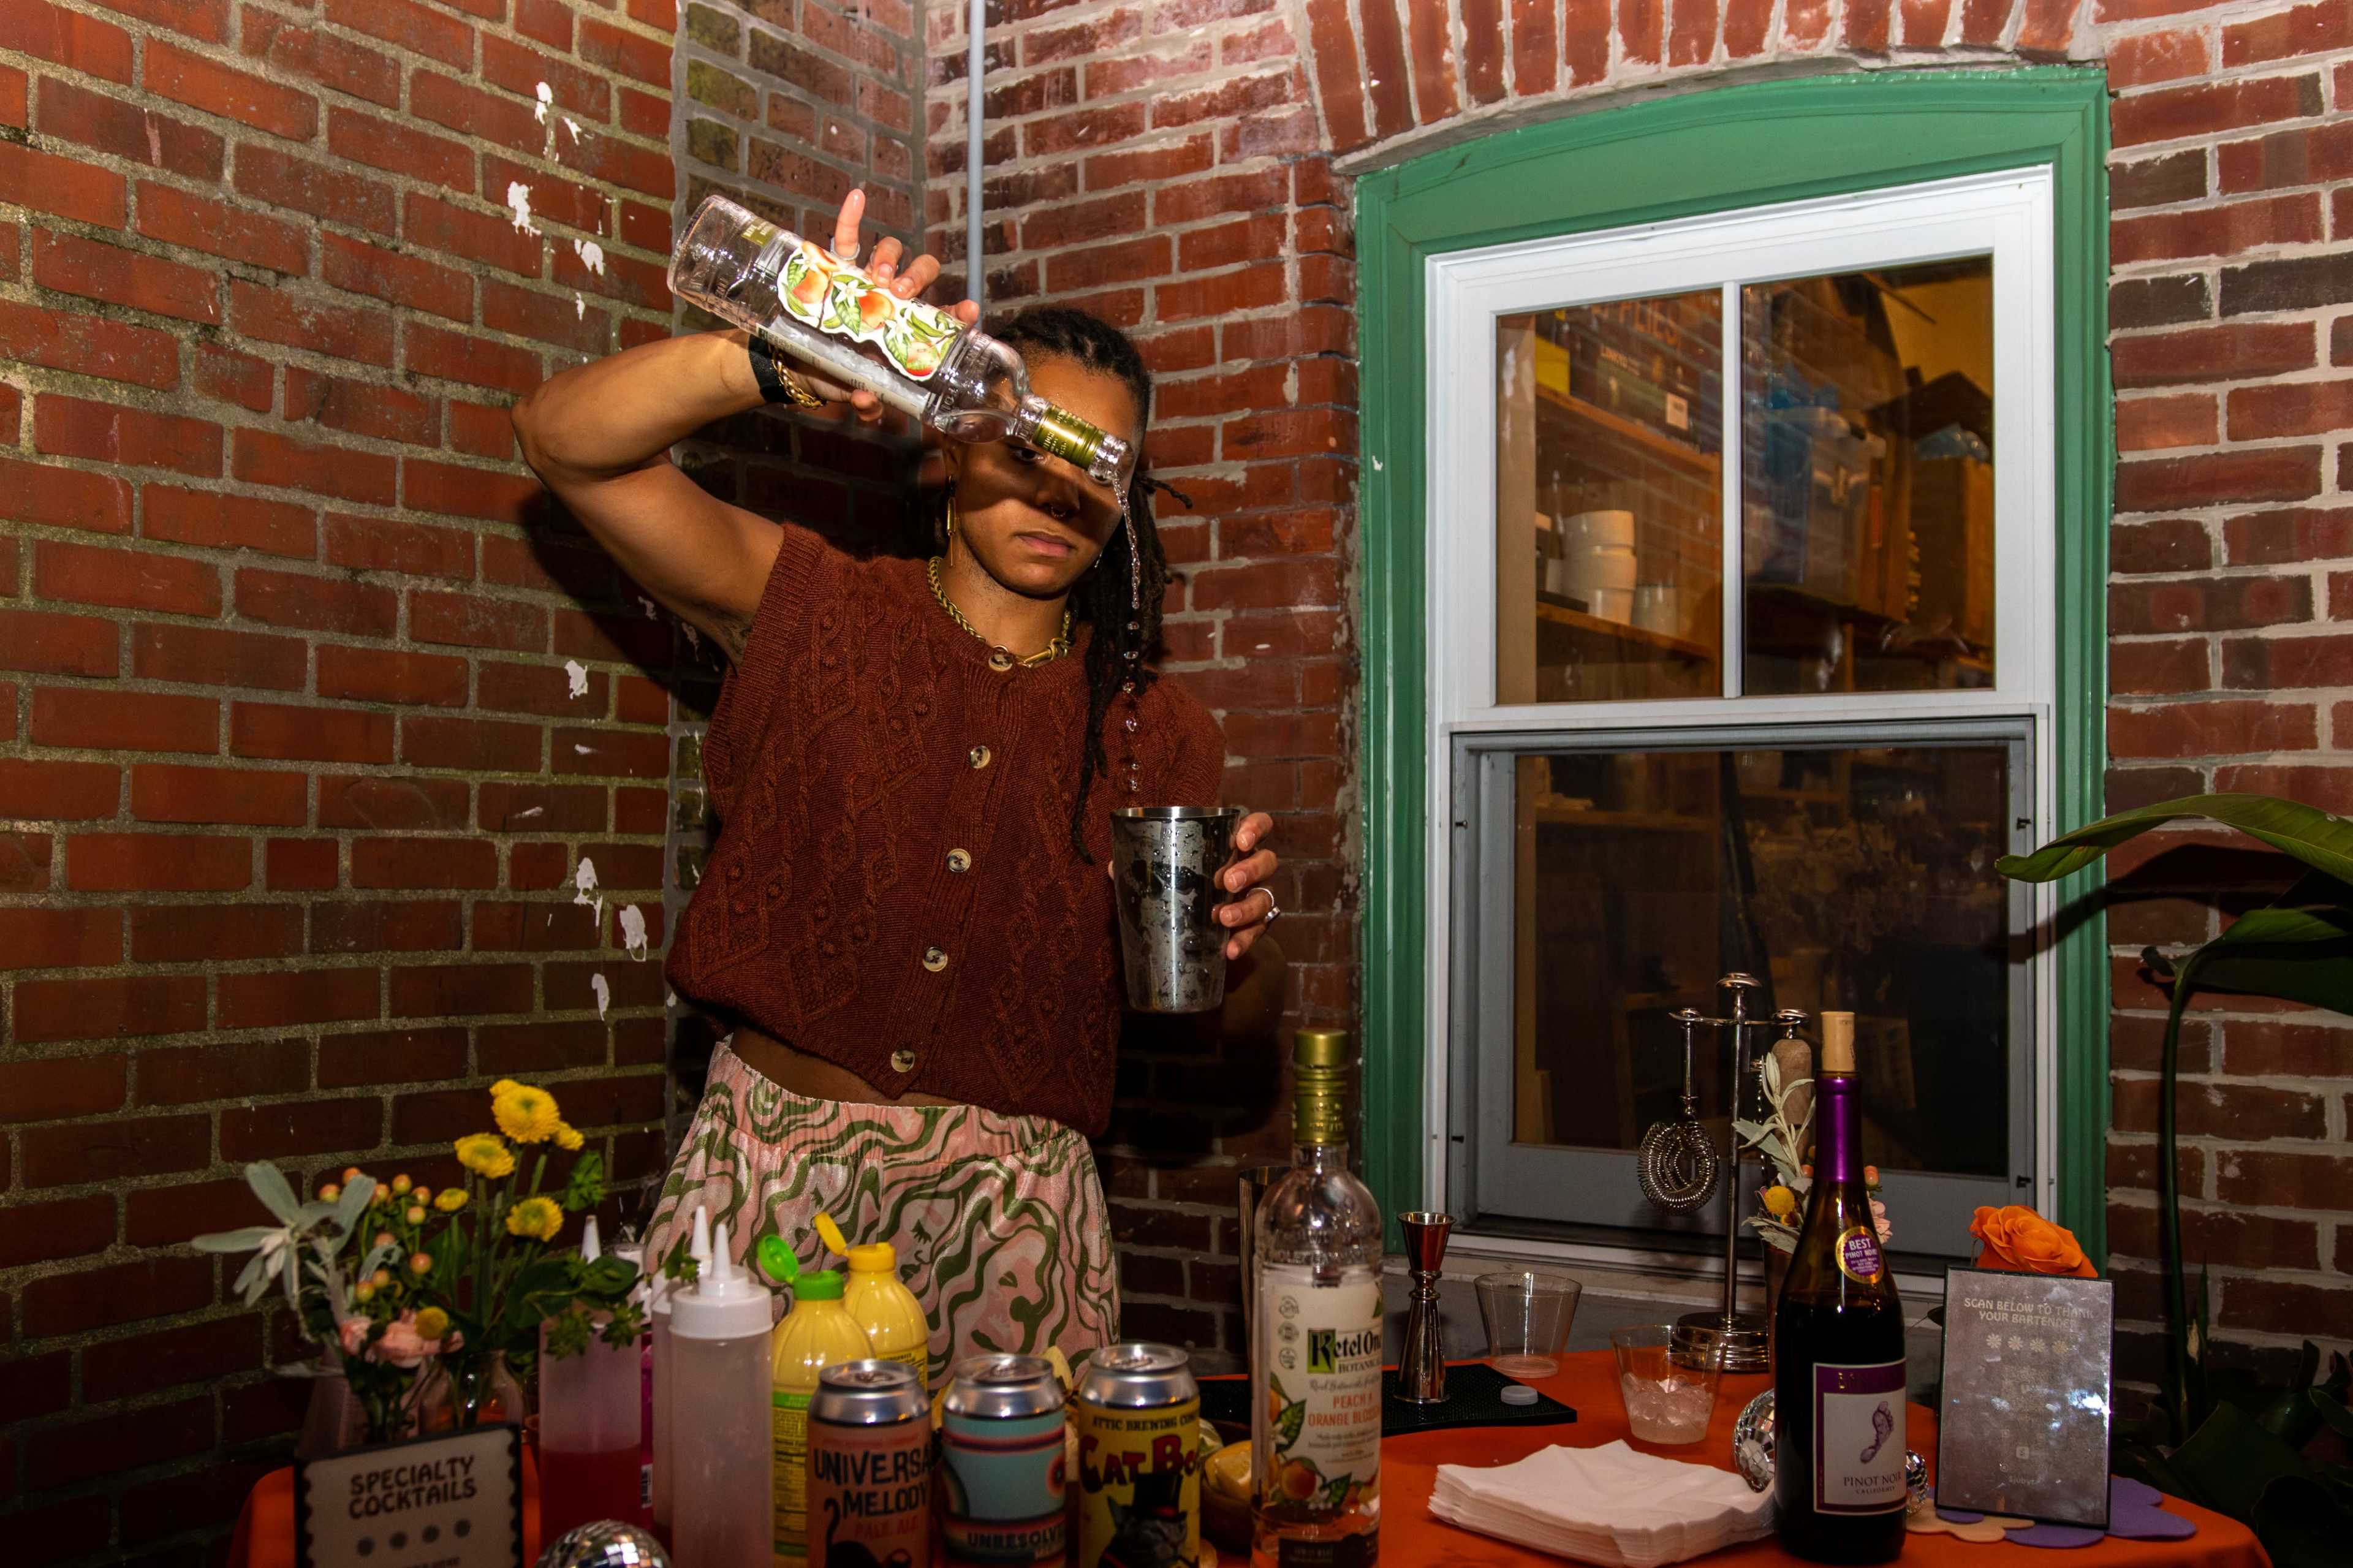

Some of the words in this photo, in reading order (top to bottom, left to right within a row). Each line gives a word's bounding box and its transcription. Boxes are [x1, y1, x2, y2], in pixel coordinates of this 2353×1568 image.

[1849, 1238, 1871, 1251] BEST
[1845, 1251, 1863, 1259] PINOT
[1964, 1298, 1993, 1309] SCAN
[1996, 1300, 2034, 1313] BELOW
[2037, 1304, 2052, 1315] TO
[2056, 1306, 2095, 1320] THANK
[1979, 1310, 2009, 1322] YOUR
[2012, 1313, 2076, 1330] BARTENDER
[1311, 1333, 1362, 1371] Ketel
[1333, 1393, 1366, 1409] PEACH
[1093, 1416, 1123, 1431] ATTIC
[1126, 1417, 1177, 1431] BREWING
[1308, 1412, 1349, 1427] ORANGE
[350, 1455, 474, 1496] SPECIALTY
[1843, 1475, 1879, 1487] PINOT
[349, 1477, 477, 1520] COCKTAILS
[843, 1483, 927, 1520] MELODY
[855, 1521, 890, 1539] PALE
[897, 1516, 919, 1535] ALE
